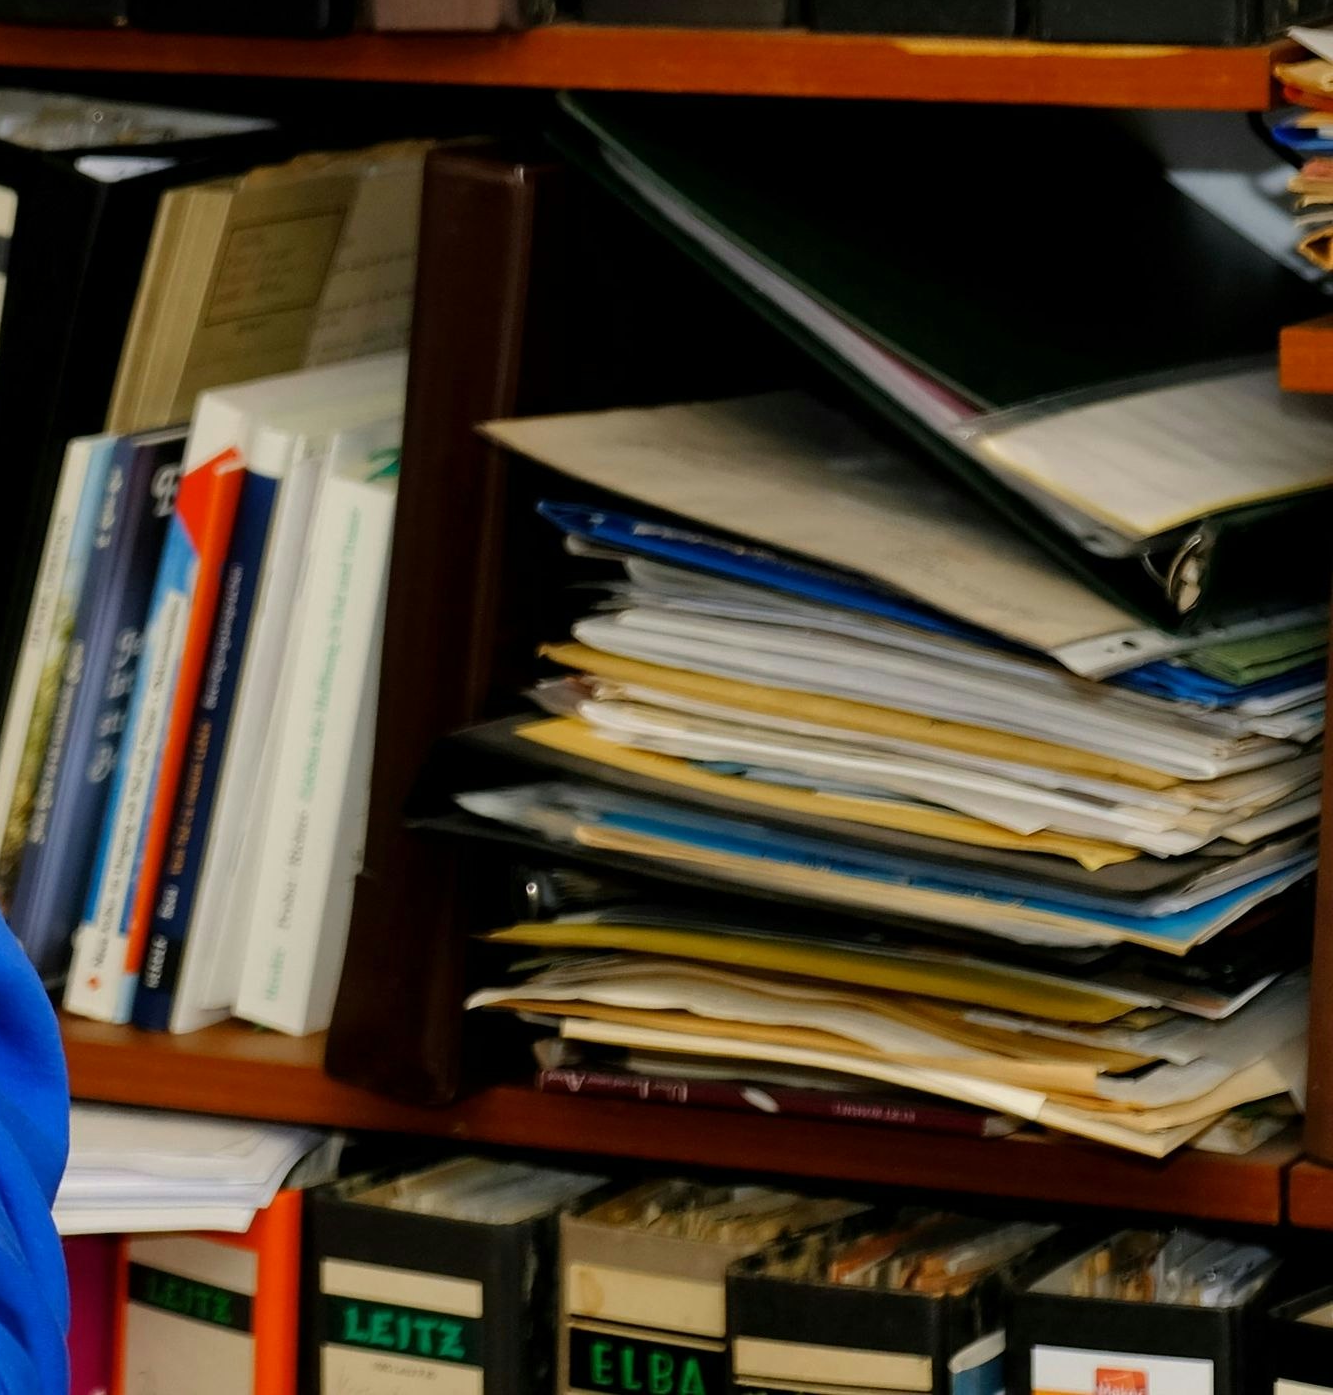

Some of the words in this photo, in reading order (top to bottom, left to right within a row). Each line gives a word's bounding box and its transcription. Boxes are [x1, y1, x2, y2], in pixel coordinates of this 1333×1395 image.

[145, 1270, 233, 1325] LEITZ
[343, 1305, 466, 1359] LEITZ
[590, 1341, 705, 1395] ELBA
